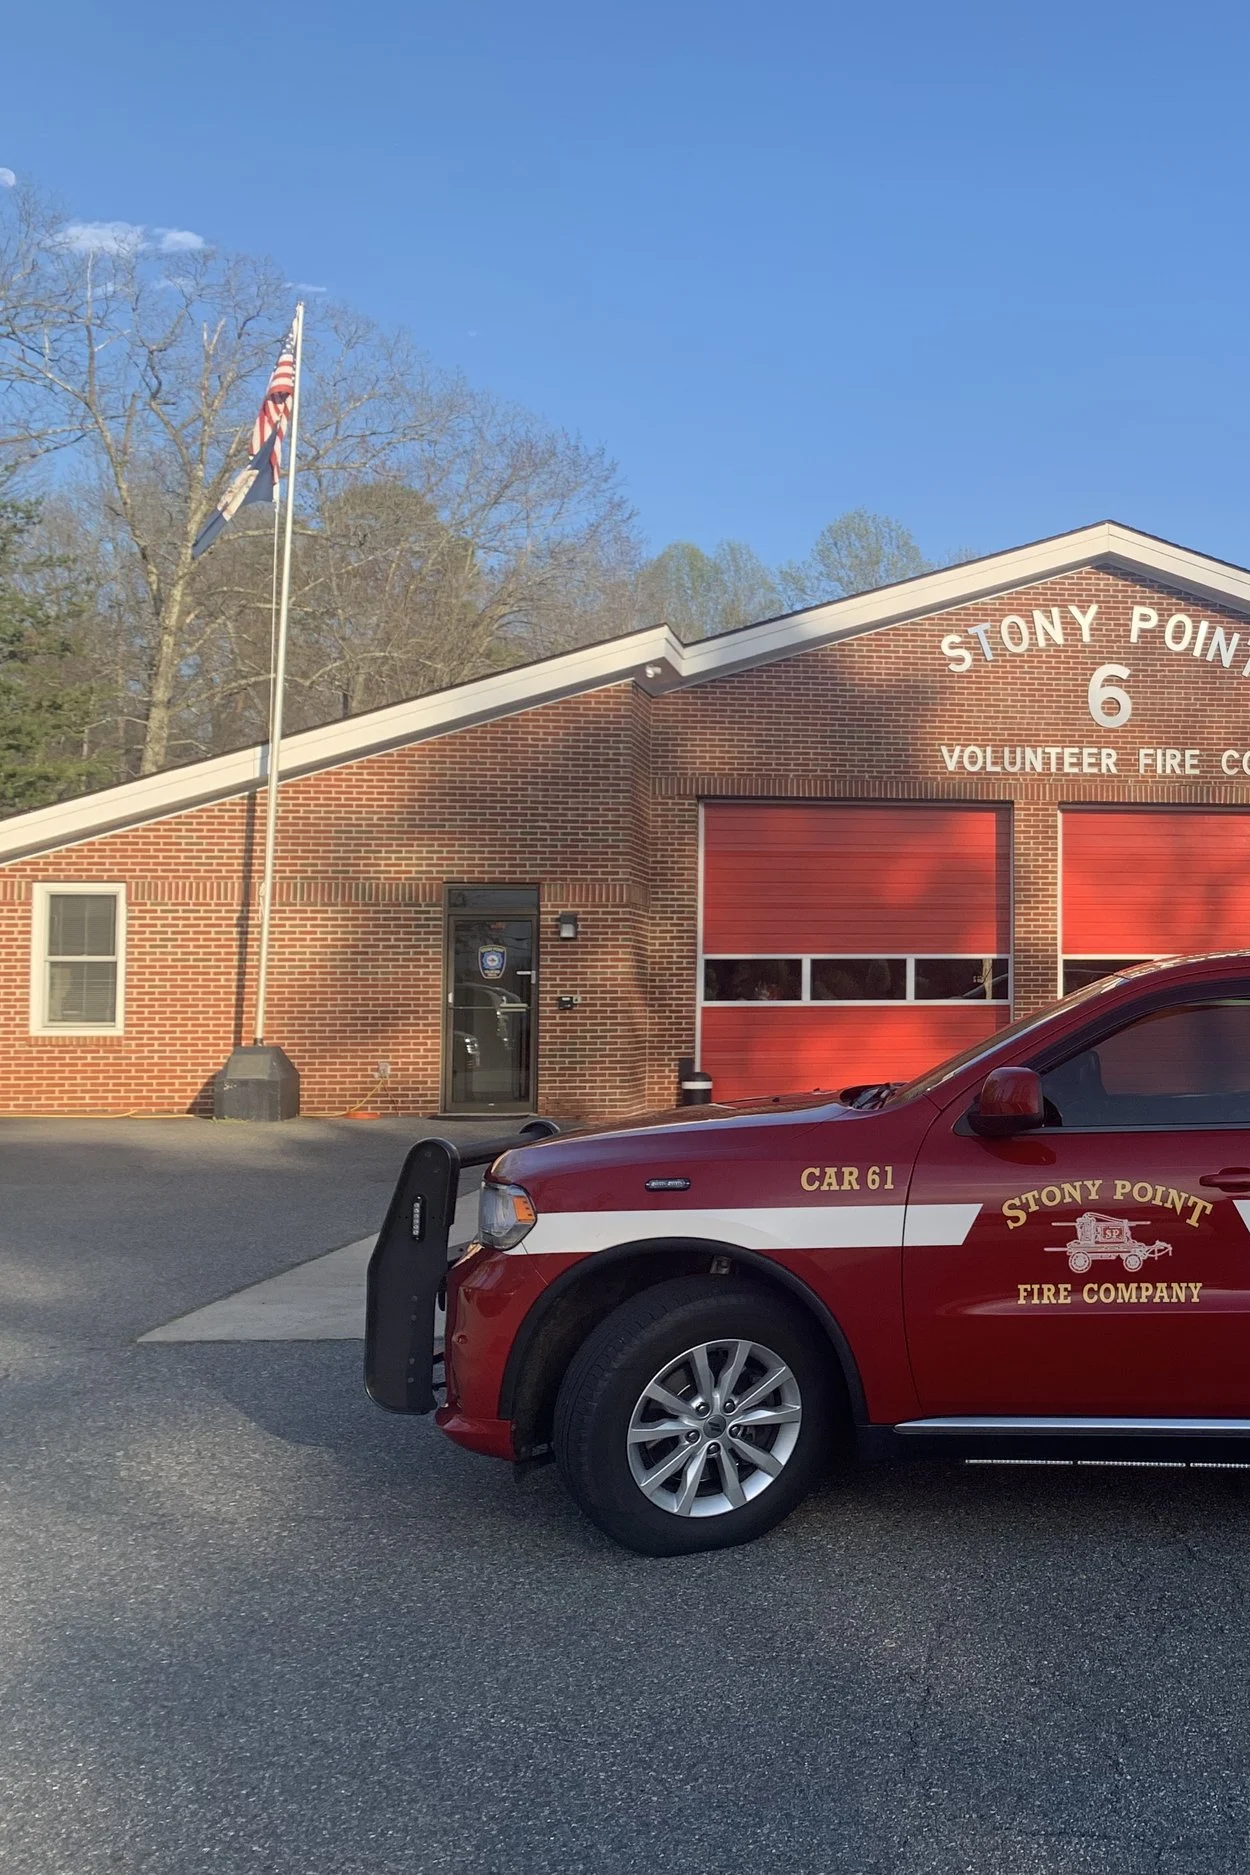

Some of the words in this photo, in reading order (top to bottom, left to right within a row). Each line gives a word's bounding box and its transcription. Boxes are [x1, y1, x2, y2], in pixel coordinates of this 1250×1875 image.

[940, 603, 1099, 673] STONY
[1087, 663, 1132, 729] 6
[940, 745, 1118, 774] VOLUNTEER
[1138, 748, 1200, 775] FIRE
[800, 1166, 860, 1192] CAR
[866, 1165, 895, 1190] 61
[1001, 1179, 1103, 1230] STONY
[1113, 1179, 1214, 1228] POINT
[1017, 1284, 1072, 1305] FIRE
[1082, 1282, 1203, 1304] COMPANY
